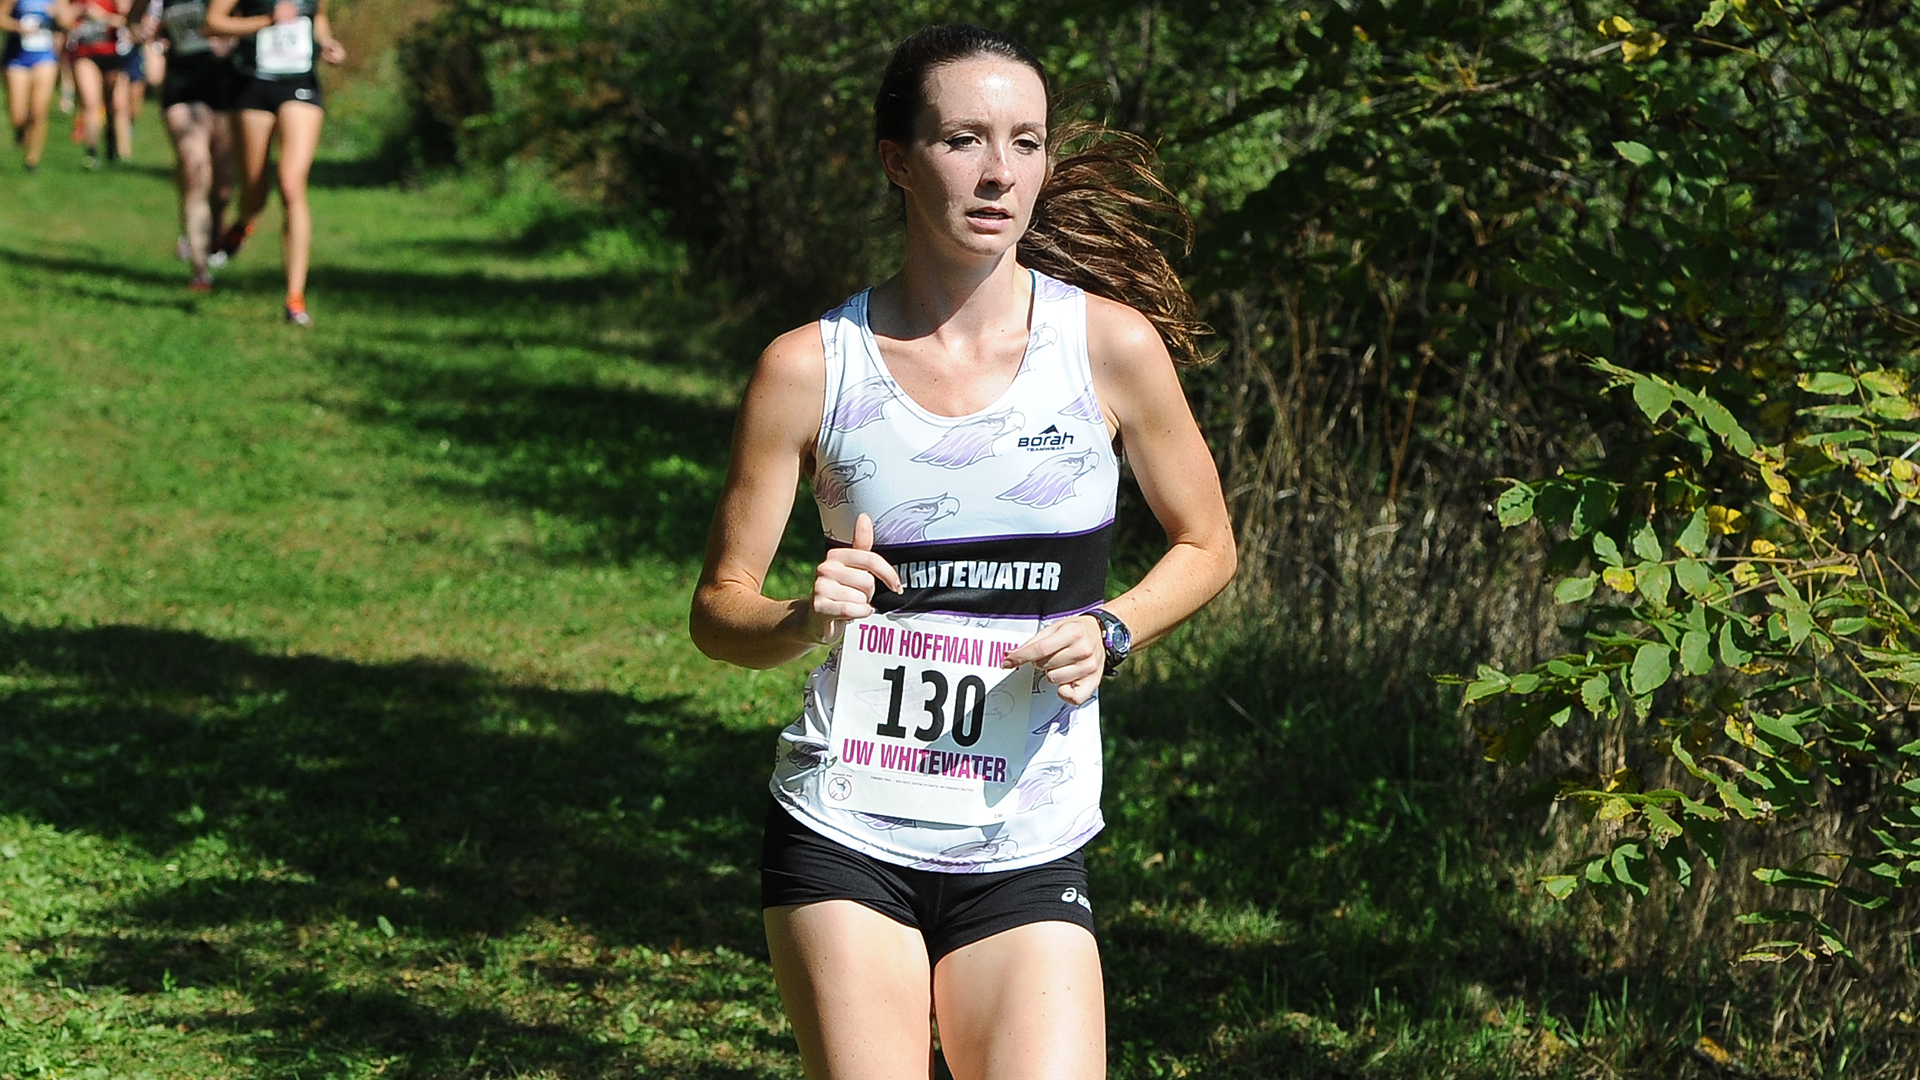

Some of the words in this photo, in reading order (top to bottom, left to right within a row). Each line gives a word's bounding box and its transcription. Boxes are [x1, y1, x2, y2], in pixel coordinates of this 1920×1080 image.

[859, 624, 895, 655] TOM
[899, 630, 984, 666] HOFFMAN
[877, 665, 986, 747] 130
[842, 739, 875, 766] UW
[881, 743, 1007, 783] WHITEWATER
